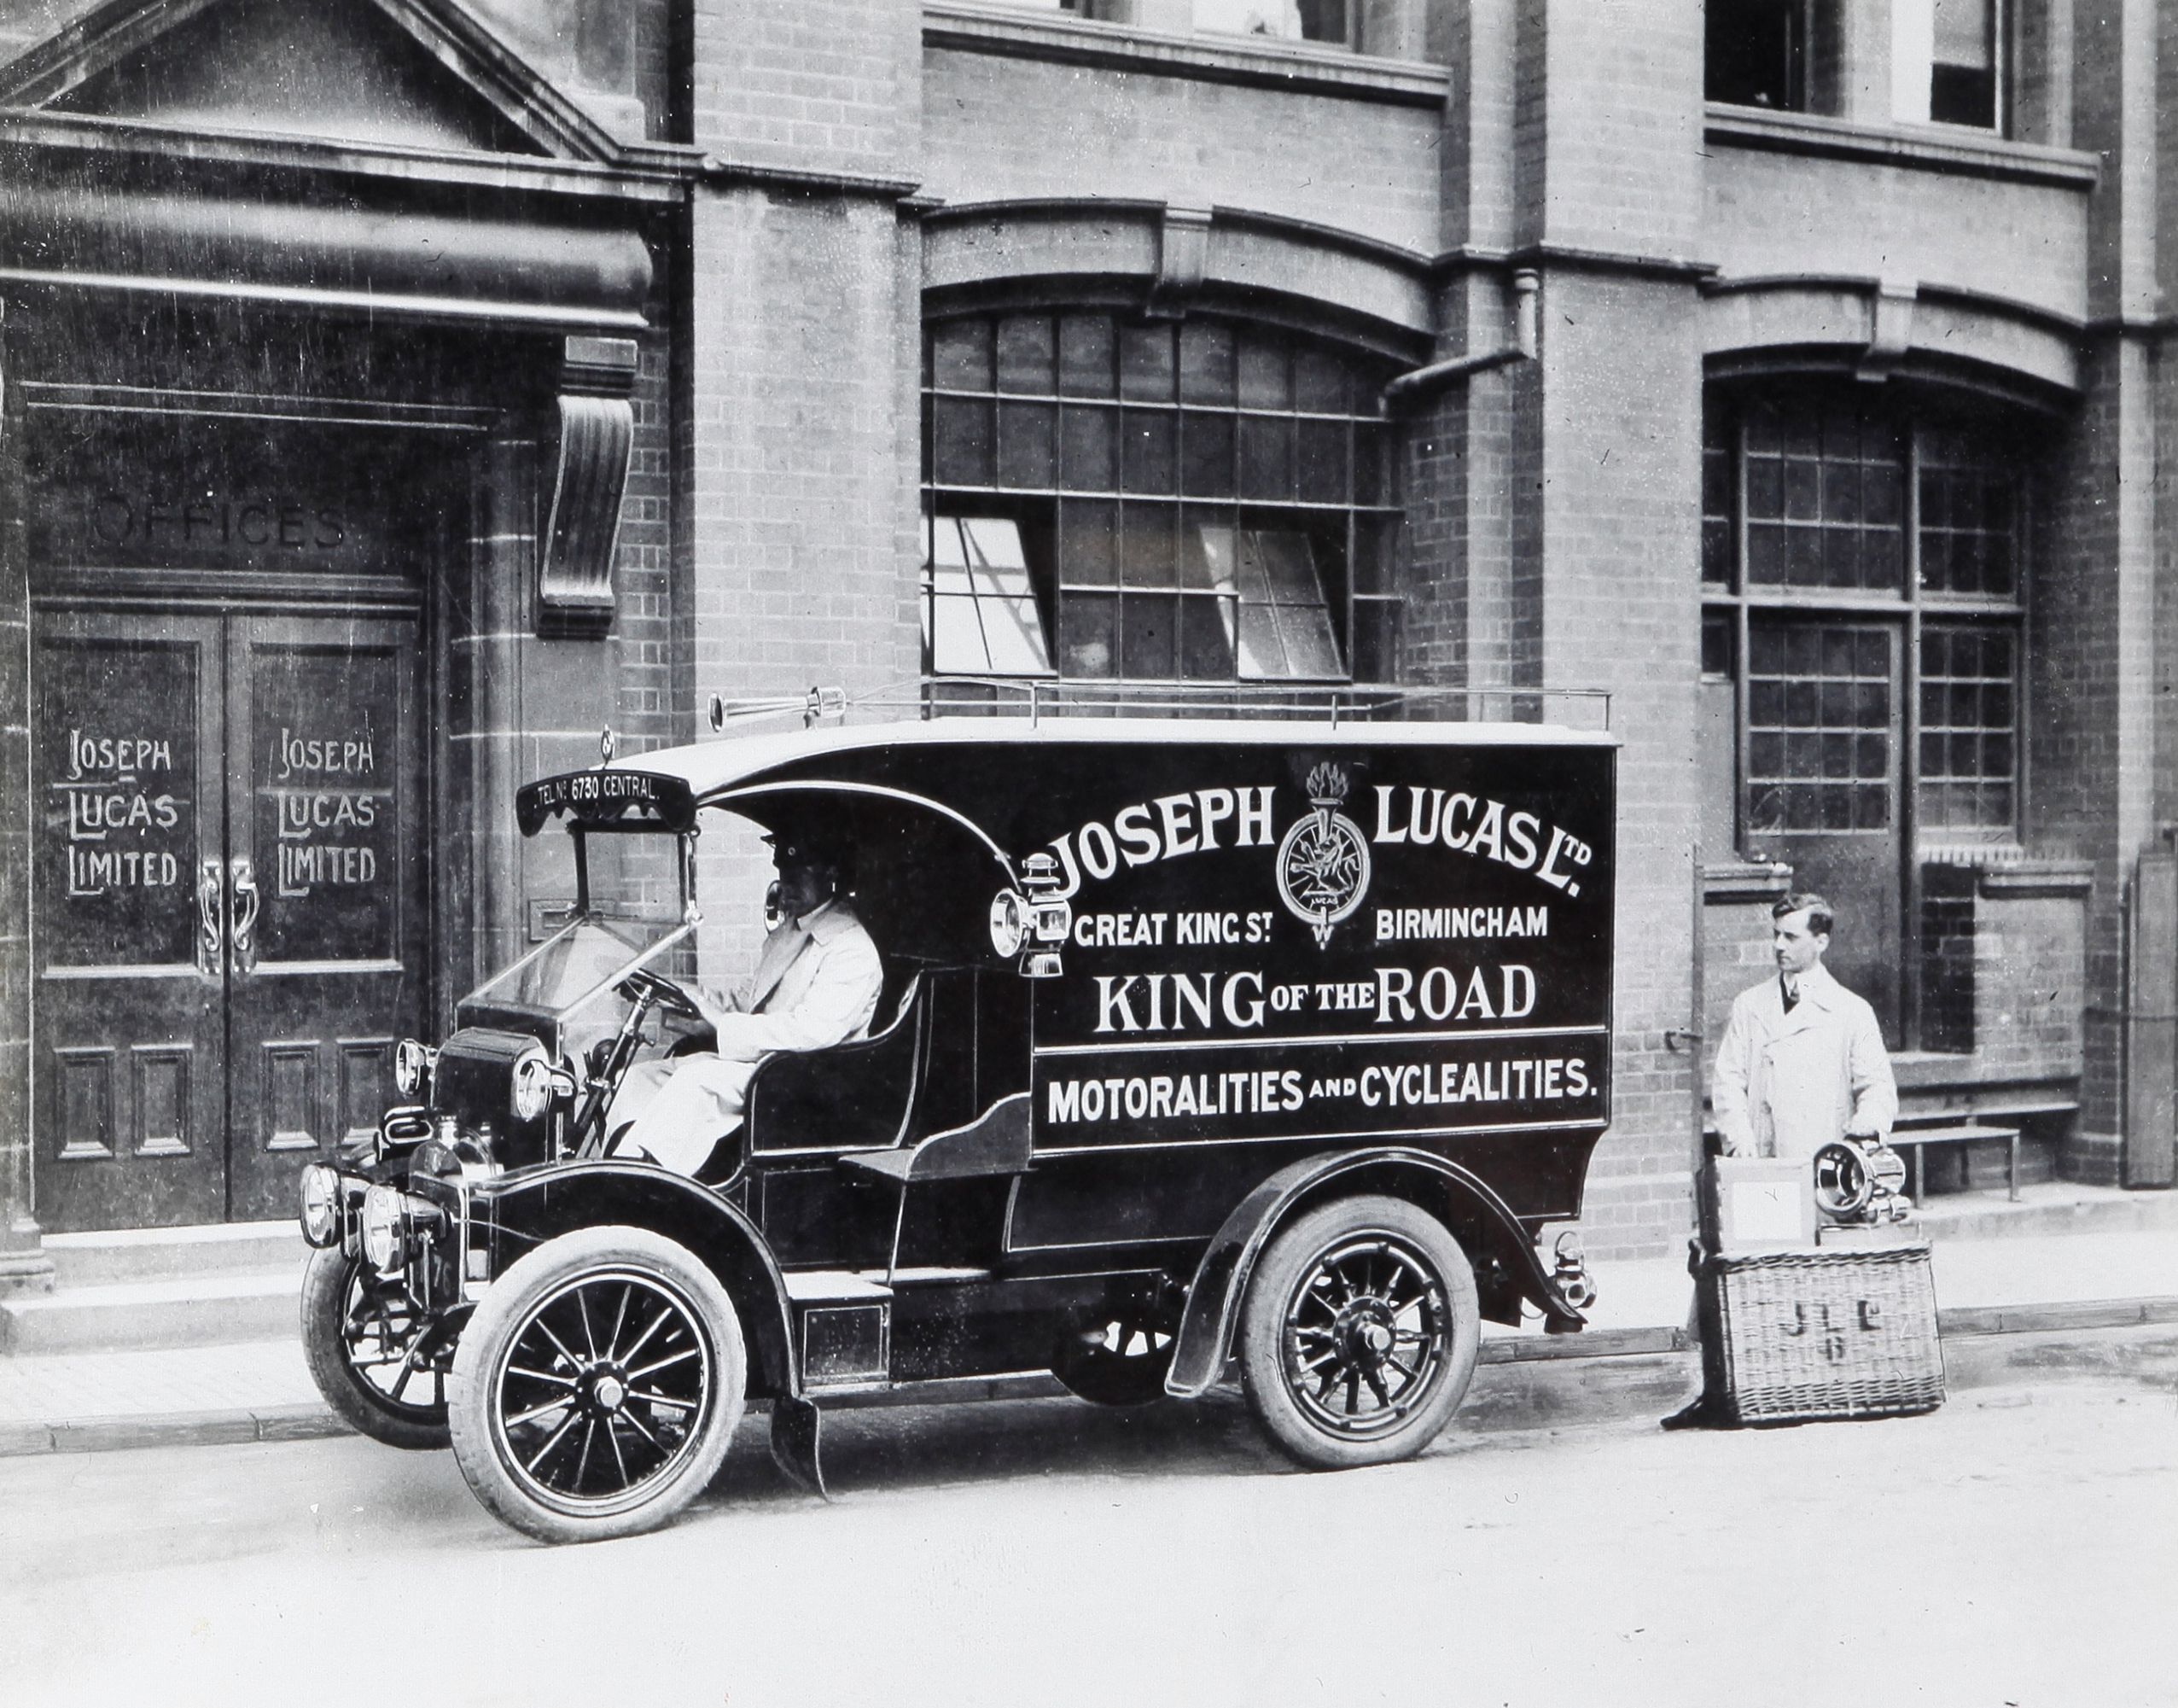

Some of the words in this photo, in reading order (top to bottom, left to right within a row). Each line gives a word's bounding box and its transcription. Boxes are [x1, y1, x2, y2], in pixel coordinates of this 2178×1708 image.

[92, 494, 344, 549] OFFICES
[67, 729, 171, 780] JOSEPH
[277, 727, 375, 779] JOSEPH
[571, 776, 599, 800] 6730
[67, 790, 178, 841] LUCAS
[277, 790, 376, 838] LUCAS
[1047, 785, 1277, 901] JOSEPH
[1372, 784, 1540, 870] LUCAS
[67, 844, 178, 895] LIMITED
[277, 842, 376, 896] LIMITED
[1074, 912, 1168, 947] GREAT
[1176, 911, 1240, 945] KING
[1376, 906, 1548, 940] BIRMINGHAM
[1092, 970, 1267, 1032] KING
[1270, 984, 1309, 1011] OF
[1315, 982, 1375, 1011] THE
[1374, 964, 1536, 1023] ROAD
[1048, 1070, 1304, 1124] MOTORALITIES
[1308, 1078, 1357, 1099] AND
[1360, 1058, 1598, 1107] CYCLEALITIES.
